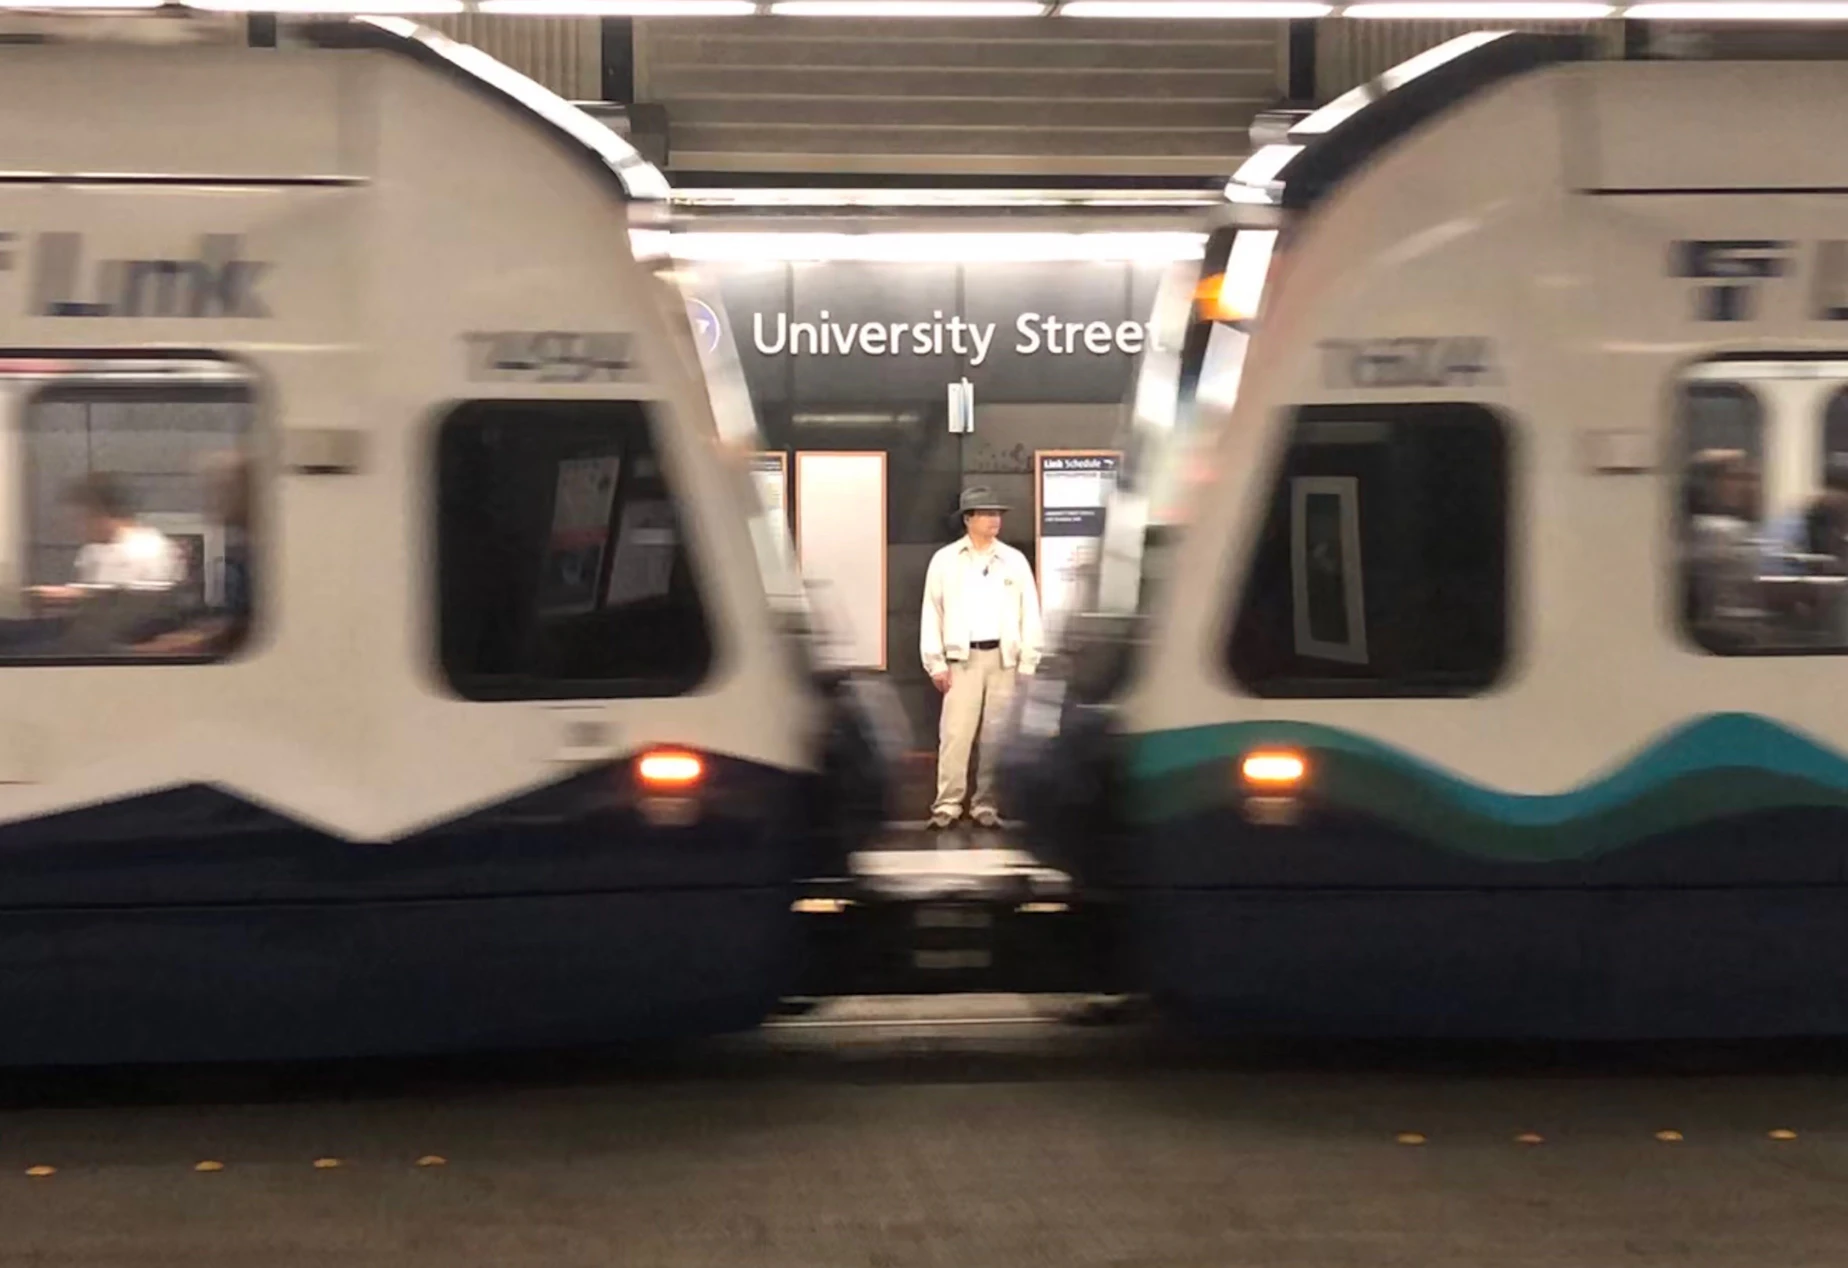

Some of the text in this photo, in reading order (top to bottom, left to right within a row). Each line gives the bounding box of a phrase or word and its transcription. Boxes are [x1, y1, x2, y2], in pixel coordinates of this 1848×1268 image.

[753, 310, 1166, 366] University Street
[1065, 459, 1102, 469] Schedule
